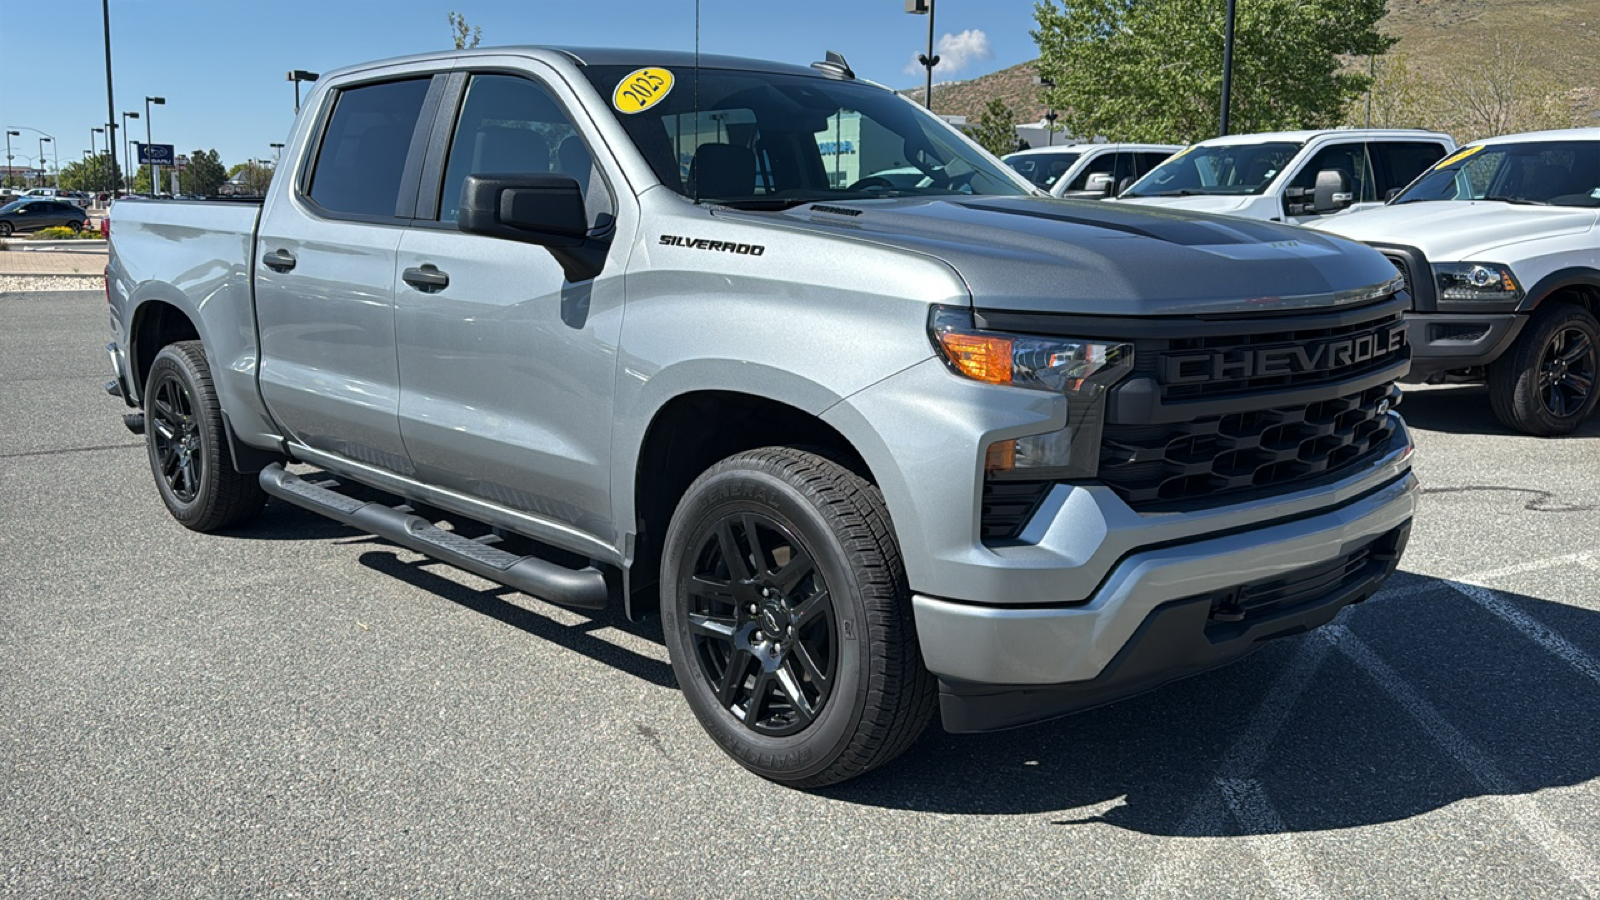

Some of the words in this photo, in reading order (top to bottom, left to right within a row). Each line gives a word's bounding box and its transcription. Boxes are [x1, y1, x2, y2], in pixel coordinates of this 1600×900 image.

[623, 71, 665, 107] 2025
[658, 234, 766, 257] SILVERADO
[1164, 323, 1410, 384] CHEVROLET
